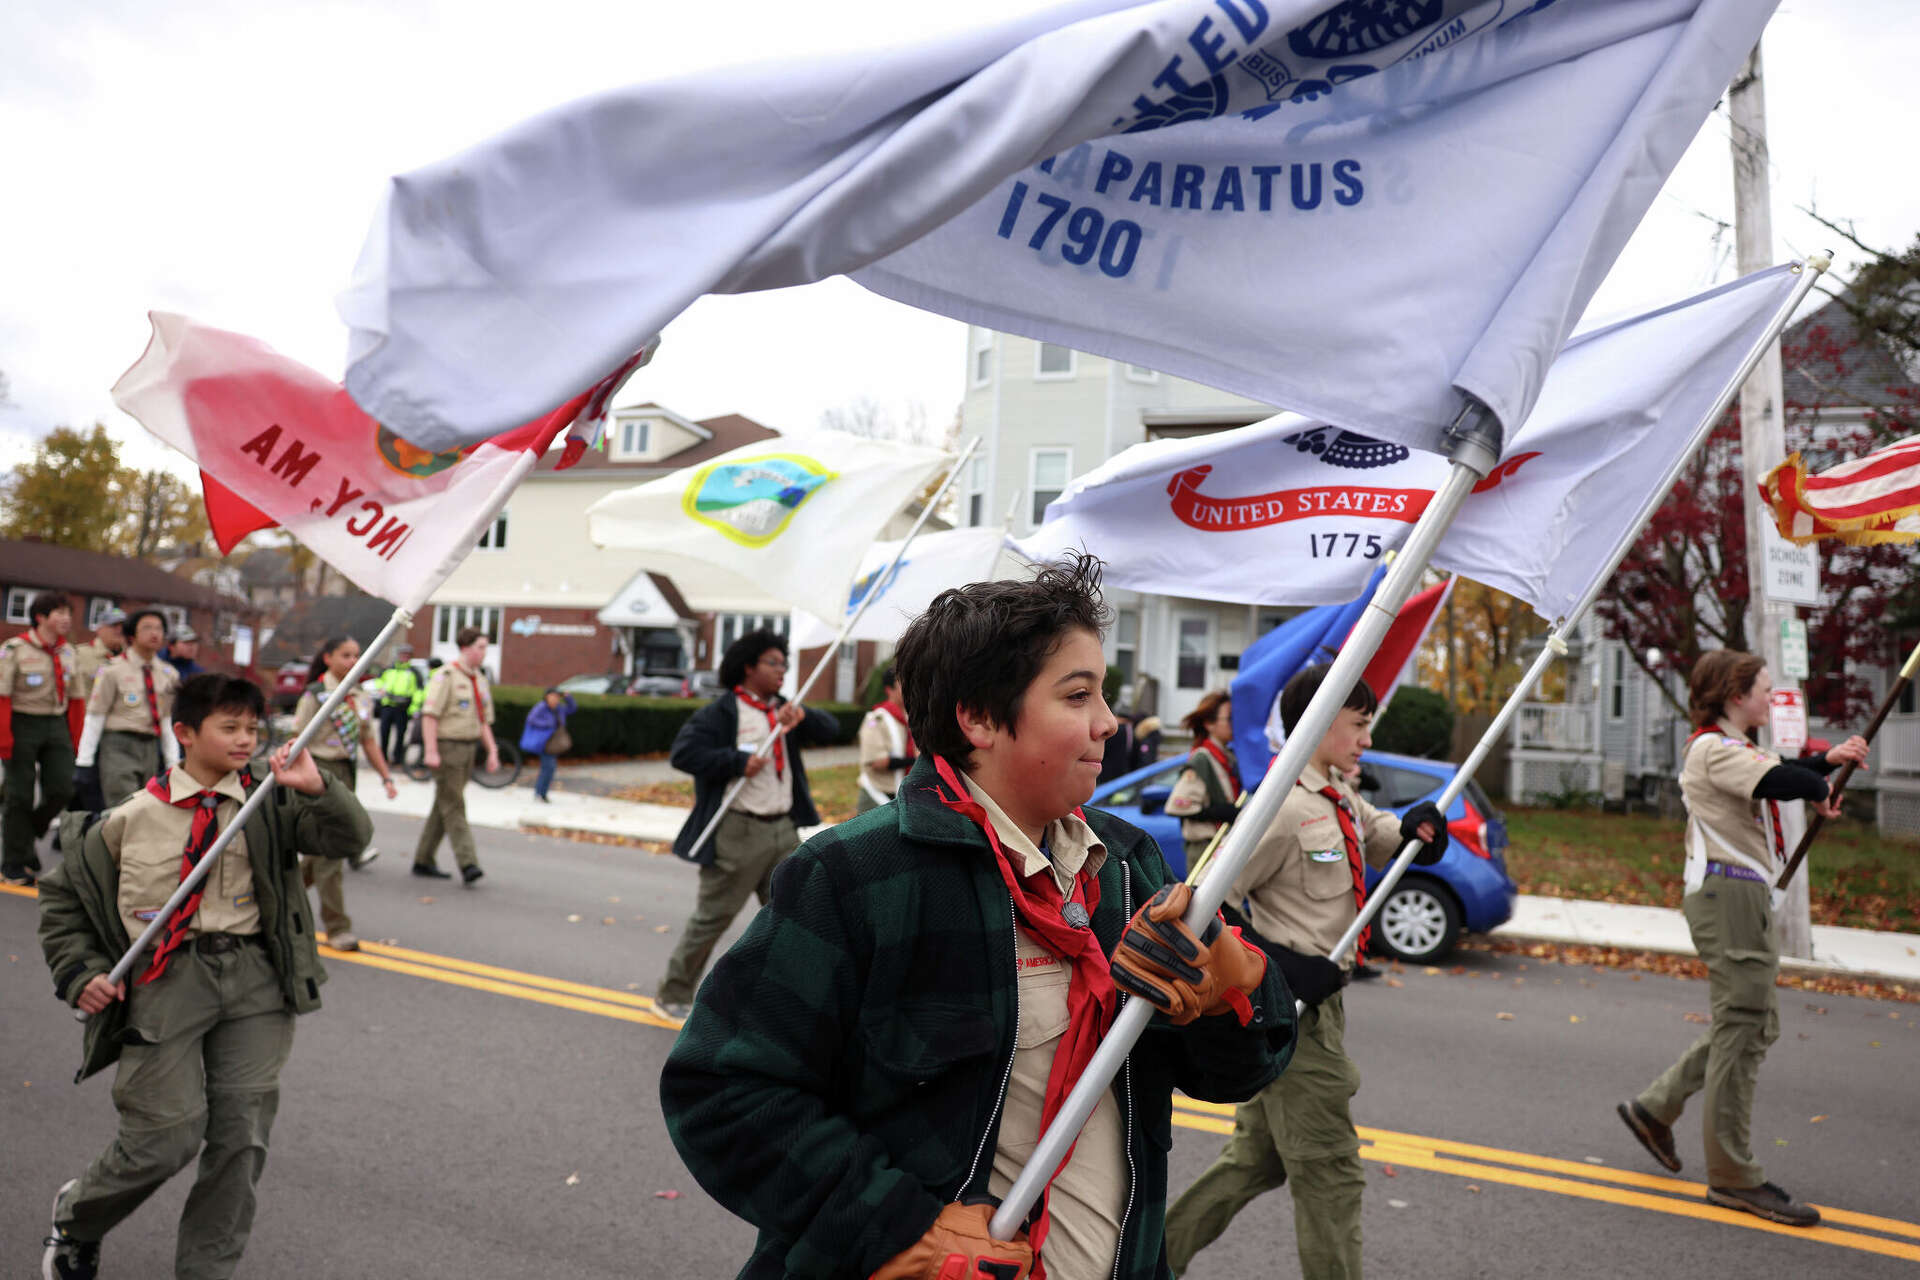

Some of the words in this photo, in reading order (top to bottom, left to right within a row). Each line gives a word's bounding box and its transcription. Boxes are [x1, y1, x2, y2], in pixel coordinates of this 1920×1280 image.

[997, 180, 1143, 279] 1790
[1191, 499, 1284, 525] UNITED
[1298, 491, 1408, 513] STATES
[1310, 533, 1382, 559] 1775
[1769, 547, 1811, 566] SCHOOL
[1778, 568, 1805, 587] ZONE
